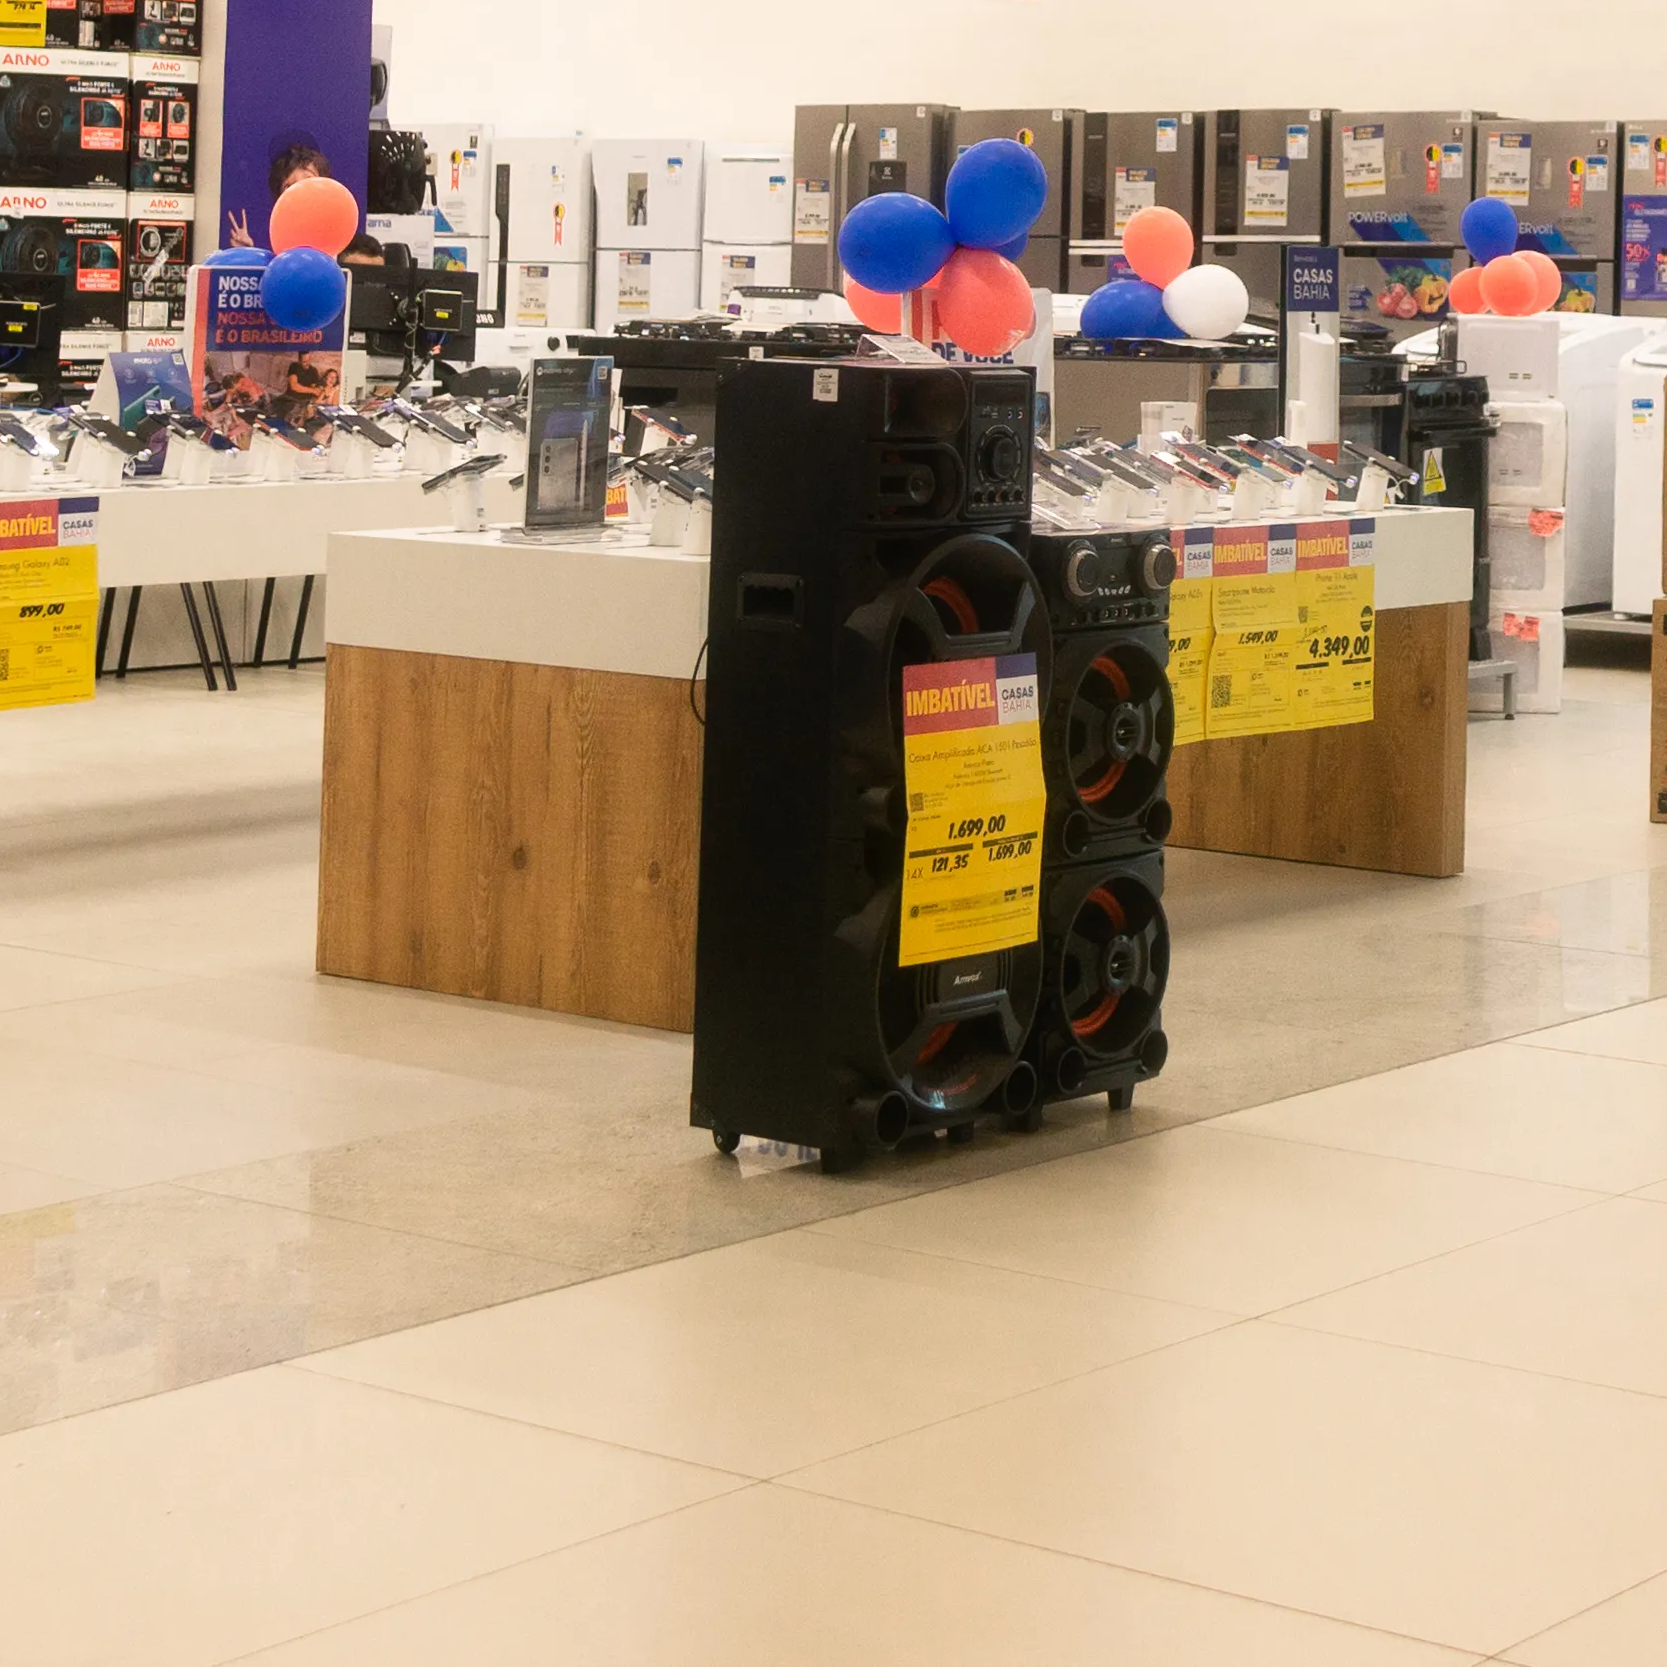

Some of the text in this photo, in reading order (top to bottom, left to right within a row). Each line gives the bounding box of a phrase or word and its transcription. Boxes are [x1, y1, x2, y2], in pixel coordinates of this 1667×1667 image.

[1, 53, 50, 67] ARNO
[152, 61, 181, 72] ARNO
[0, 195, 48, 210] ARNO
[149, 199, 179, 210] ARNO
[1293, 267, 1333, 284] CASAS
[217, 290, 228, 308] É
[229, 294, 241, 309] O
[1293, 284, 1331, 300] BAHIA
[217, 311, 266, 326] NOSSA
[146, 337, 176, 348] ARNO
[215, 326, 225, 344] É
[227, 329, 238, 343] O
[931, 341, 957, 362] DE
[63, 518, 94, 531] CASAS
[63, 528, 93, 539] BAHIA
[1213, 539, 1294, 565] IMBATÍVEL CASAS
[1297, 533, 1373, 558] IMBATÍVEL CASAS
[1187, 548, 1212, 561] CASAS
[1270, 555, 1292, 567] BAHIA
[22, 559, 51, 571] Galaxy
[1186, 559, 1210, 570] BAHIA
[19, 602, 65, 620] 899,00
[1238, 630, 1278, 645] 1.549,00
[1309, 635, 1370, 660] 4.349,00
[906, 678, 1034, 718] IMBATÍVEL CASAS
[1002, 699, 1032, 714] BAHIA
[908, 752, 931, 764] Caixa
[948, 814, 1006, 840] 1.699,00
[988, 840, 1033, 863] 1.699,00
[932, 853, 970, 874] 121,35
